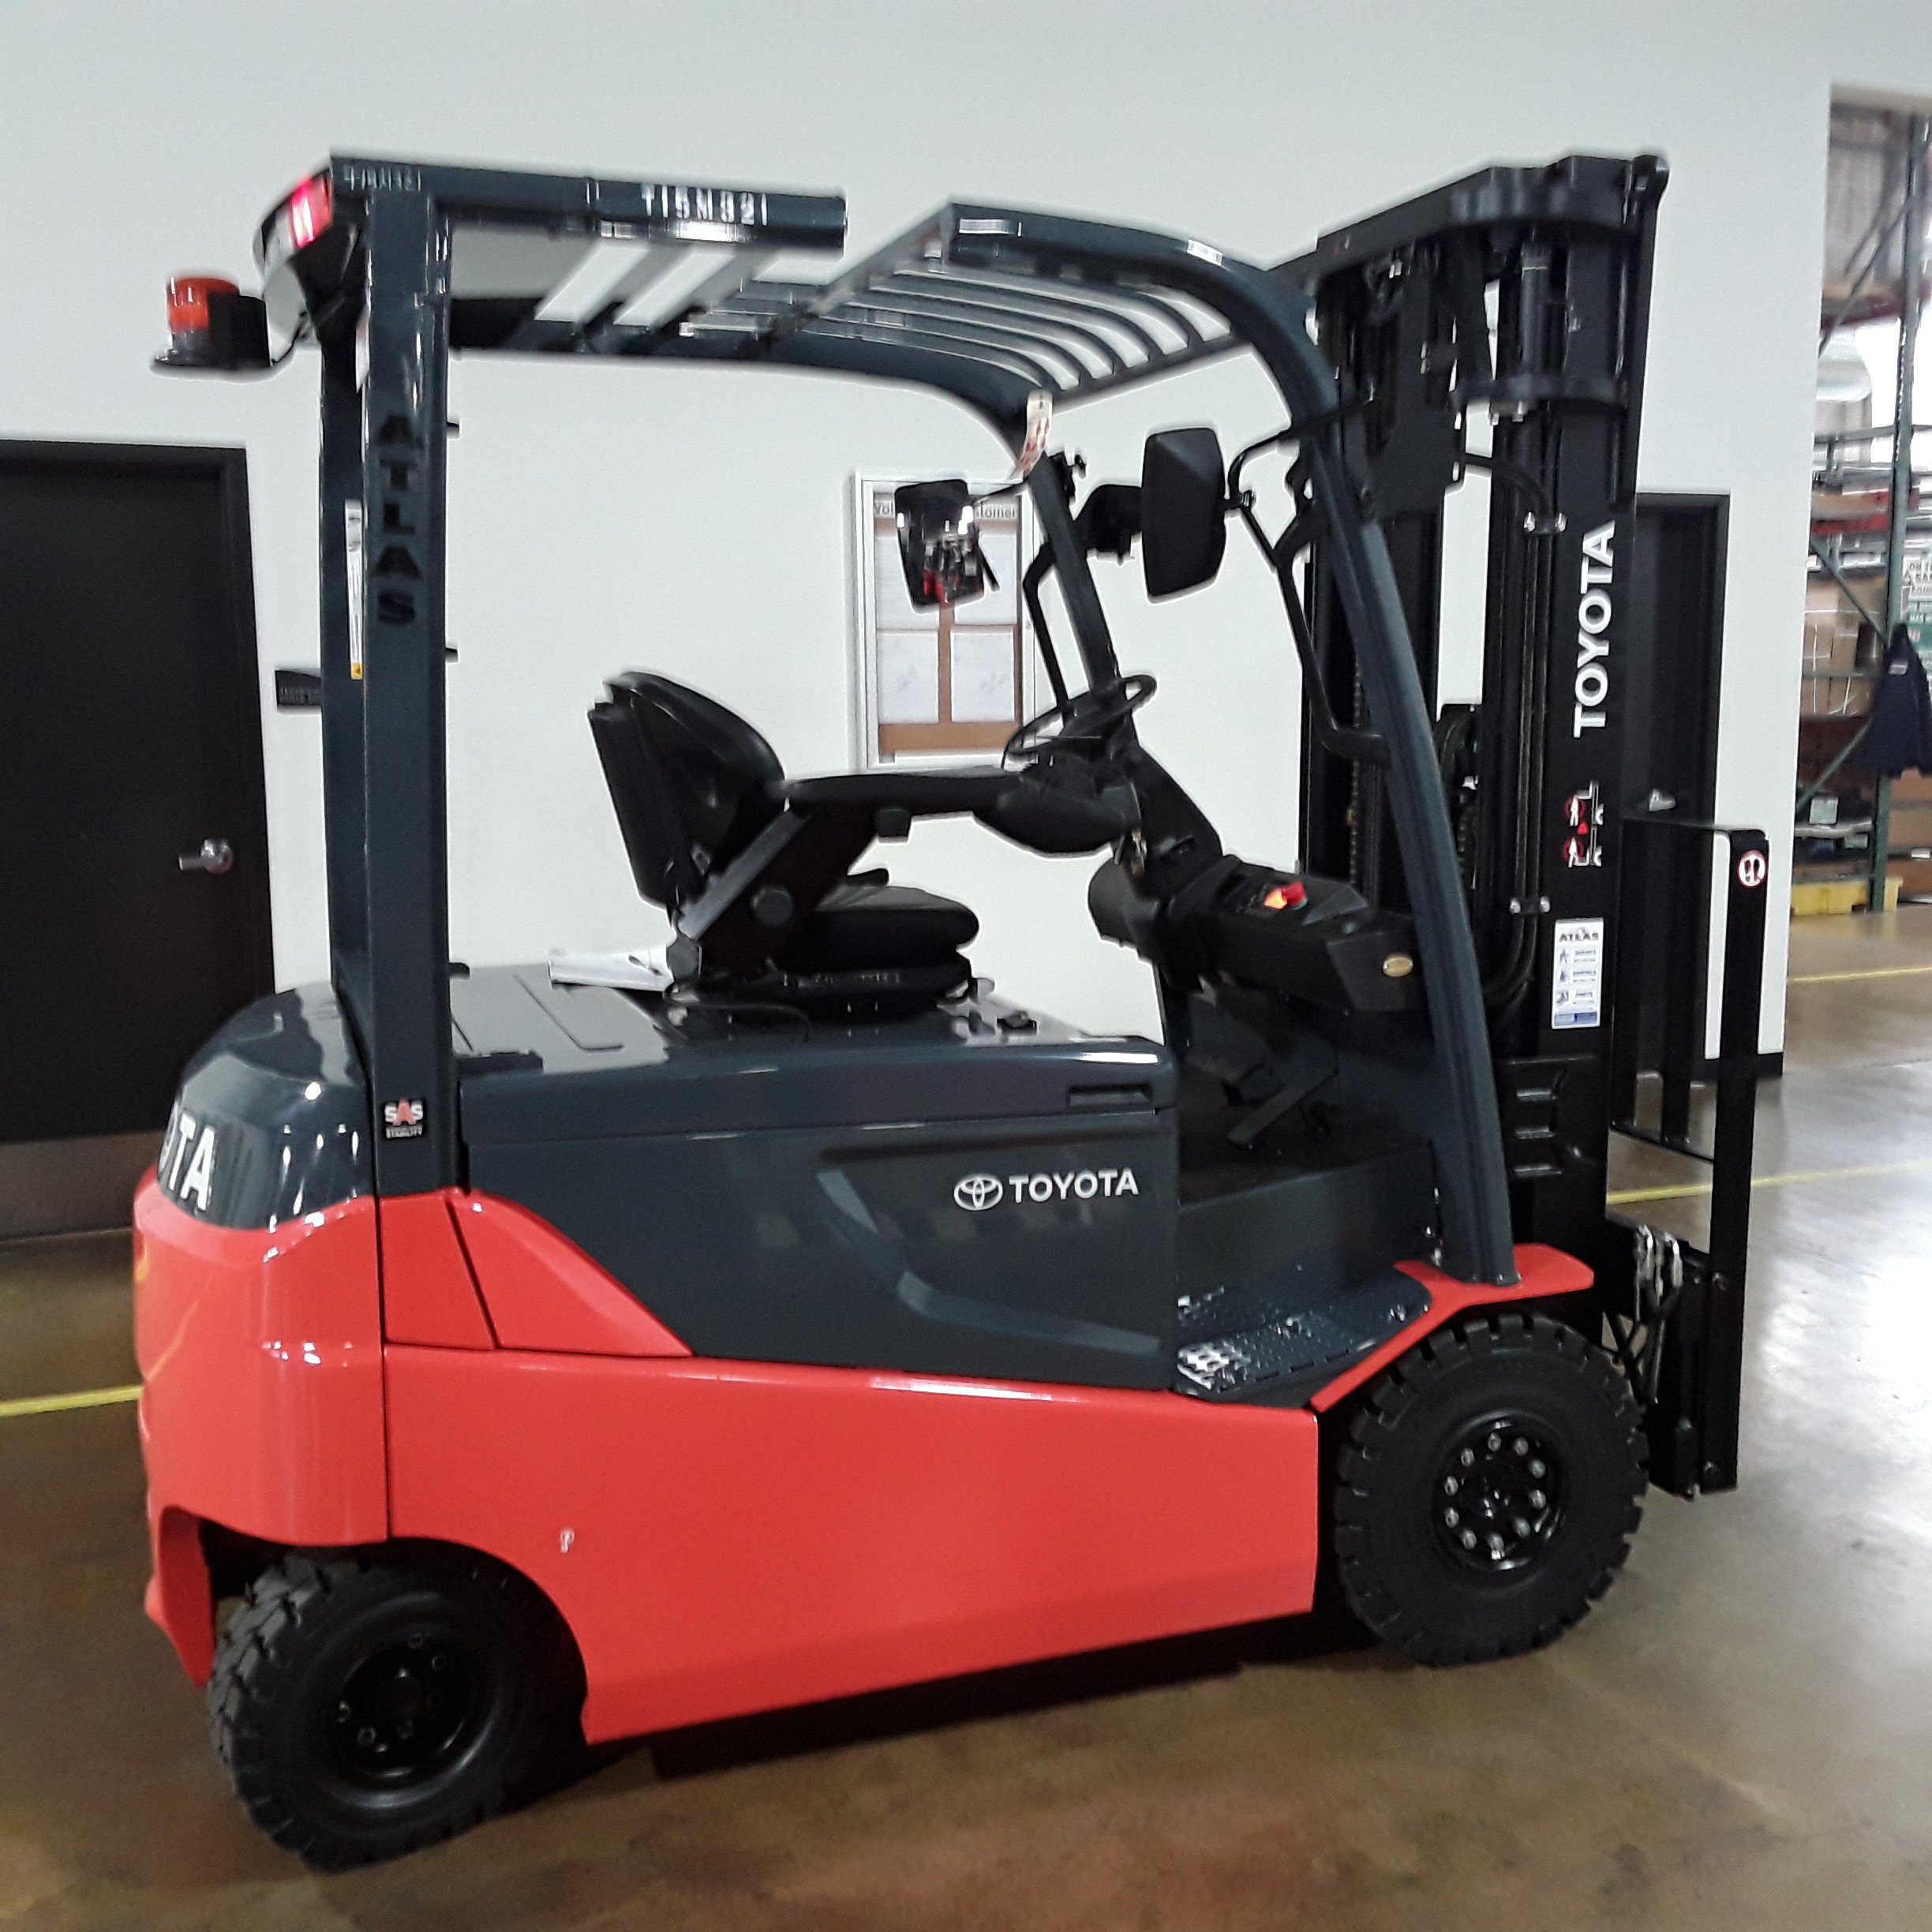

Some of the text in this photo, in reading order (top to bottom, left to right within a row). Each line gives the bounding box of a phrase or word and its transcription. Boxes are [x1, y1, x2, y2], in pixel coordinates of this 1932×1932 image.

[372, 414, 425, 625] ATLAS
[1573, 519, 1616, 739] TOYOTA
[1559, 932, 1599, 942] ATLAS
[384, 1097, 423, 1126] SAS
[1009, 1168, 1139, 1203] TOYOTA
